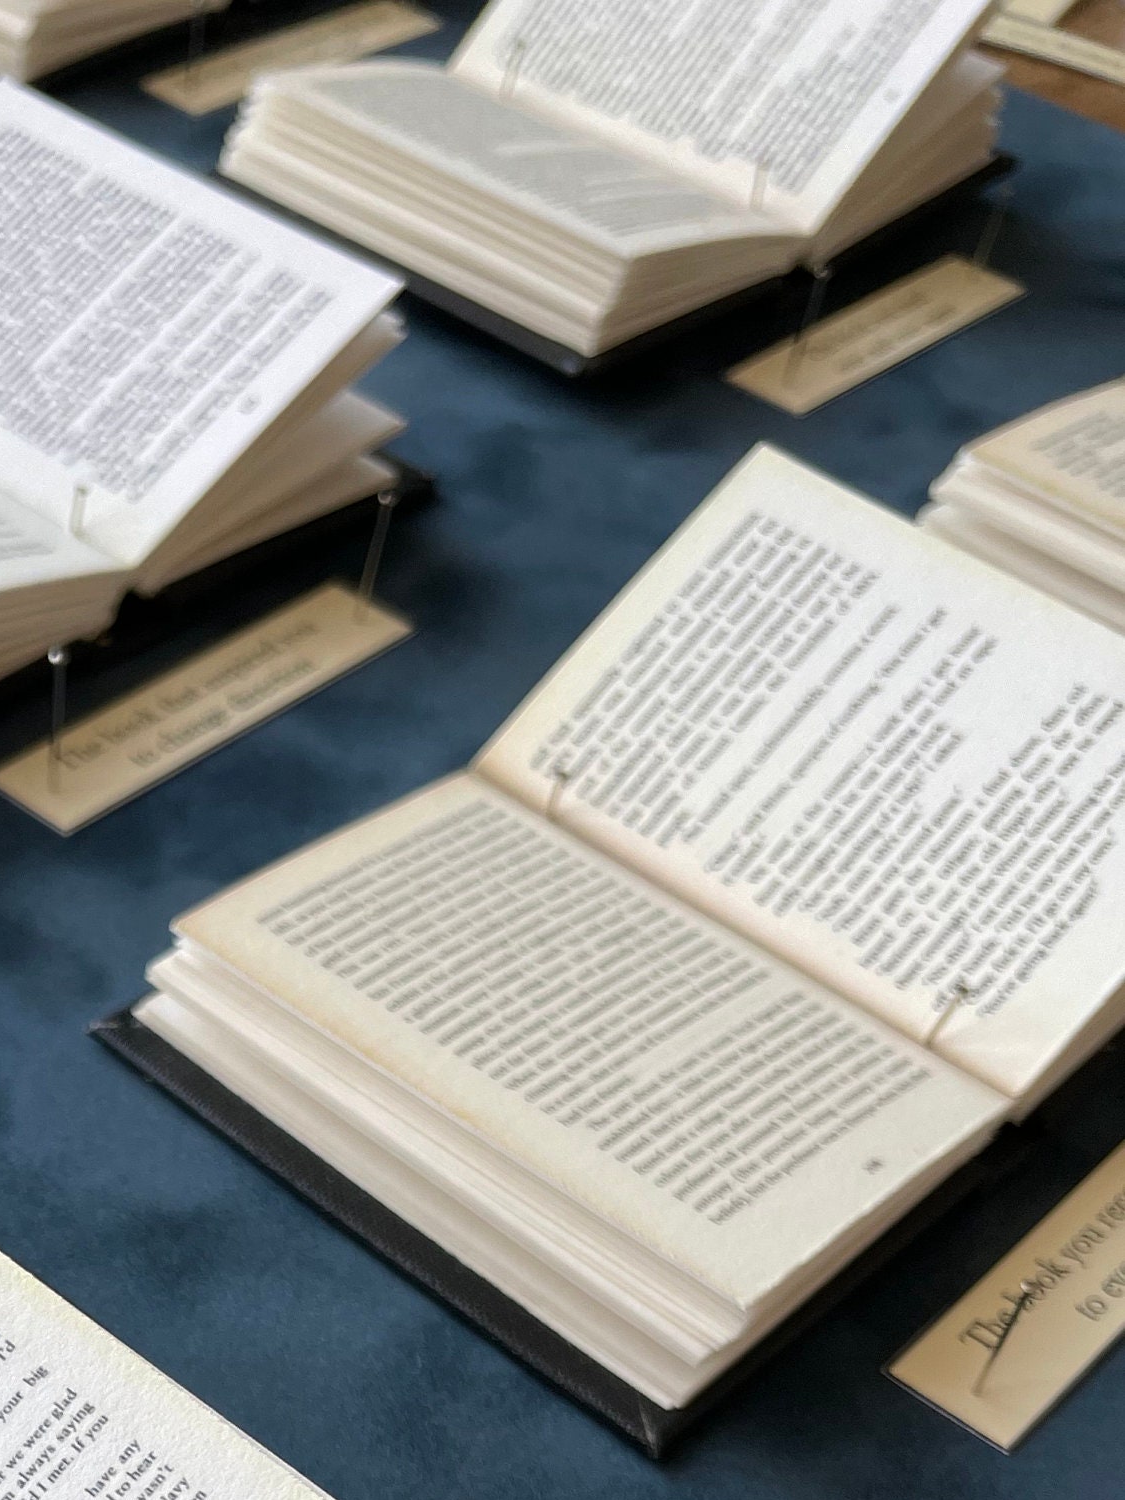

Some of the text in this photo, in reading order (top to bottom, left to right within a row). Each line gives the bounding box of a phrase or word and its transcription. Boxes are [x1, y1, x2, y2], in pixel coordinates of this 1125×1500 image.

[960, 1303, 1017, 1352] The
[1060, 1224, 1107, 1269] you
[1075, 1294, 1108, 1321] to
